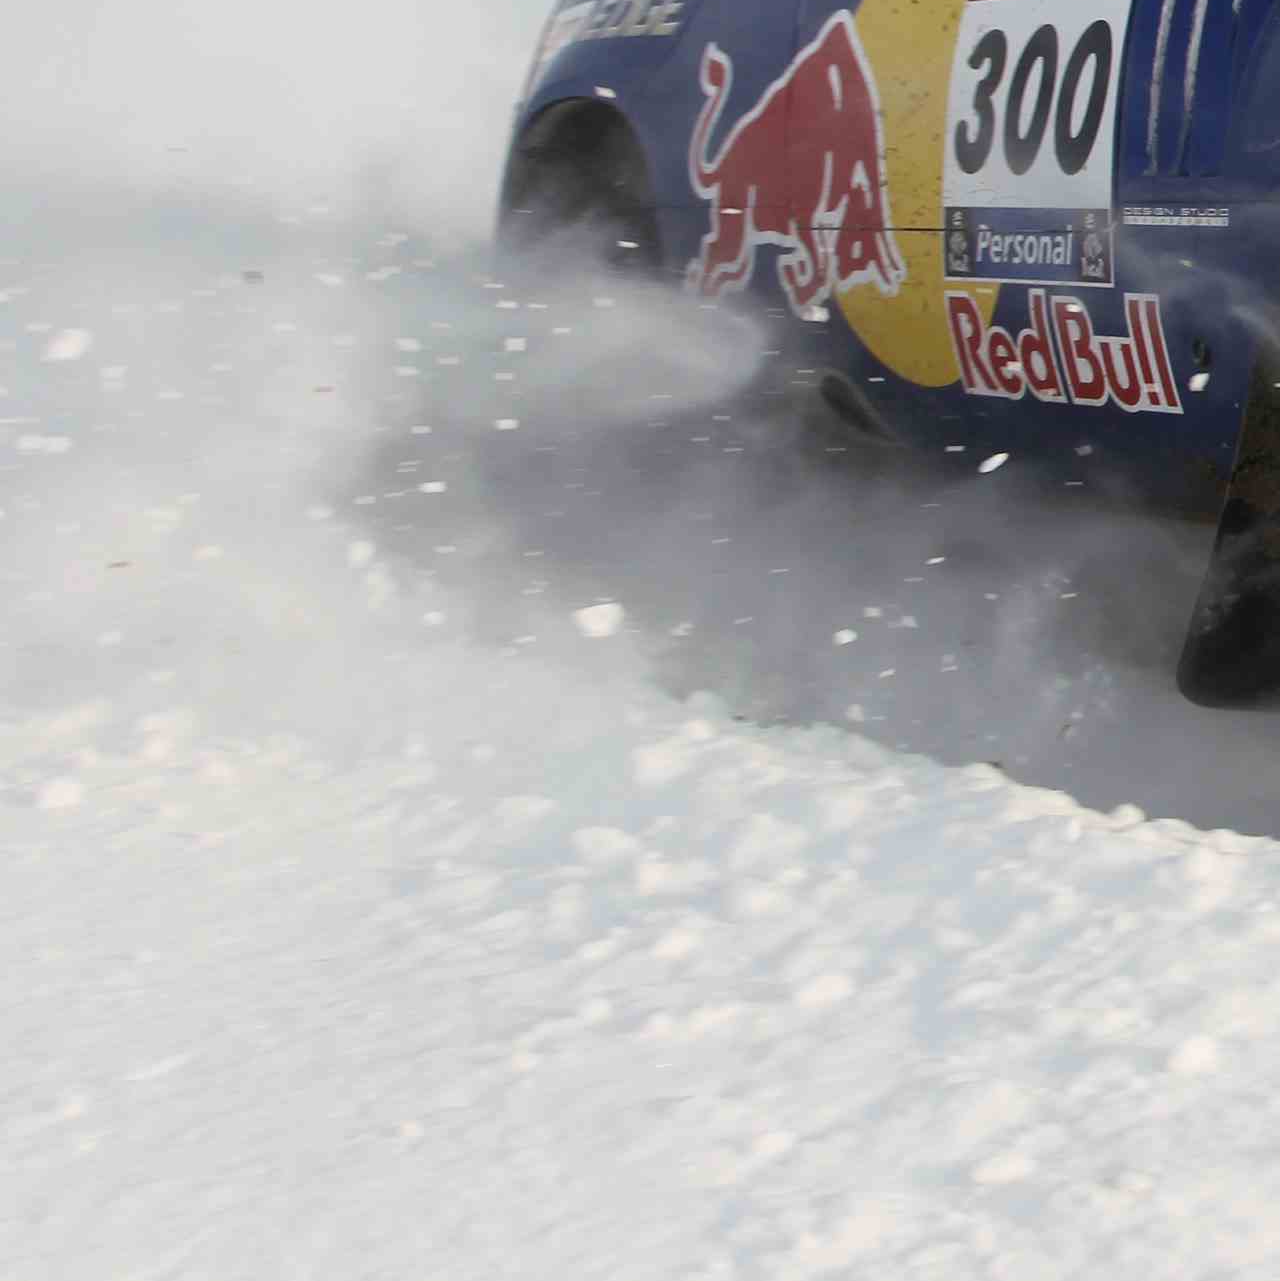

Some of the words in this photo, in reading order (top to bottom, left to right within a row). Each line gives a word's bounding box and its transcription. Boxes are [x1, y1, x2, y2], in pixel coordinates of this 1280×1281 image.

[954, 20, 1113, 176] 300
[976, 223, 1073, 265] Personal
[944, 288, 1068, 404] Red
[1051, 294, 1184, 414] Bull
